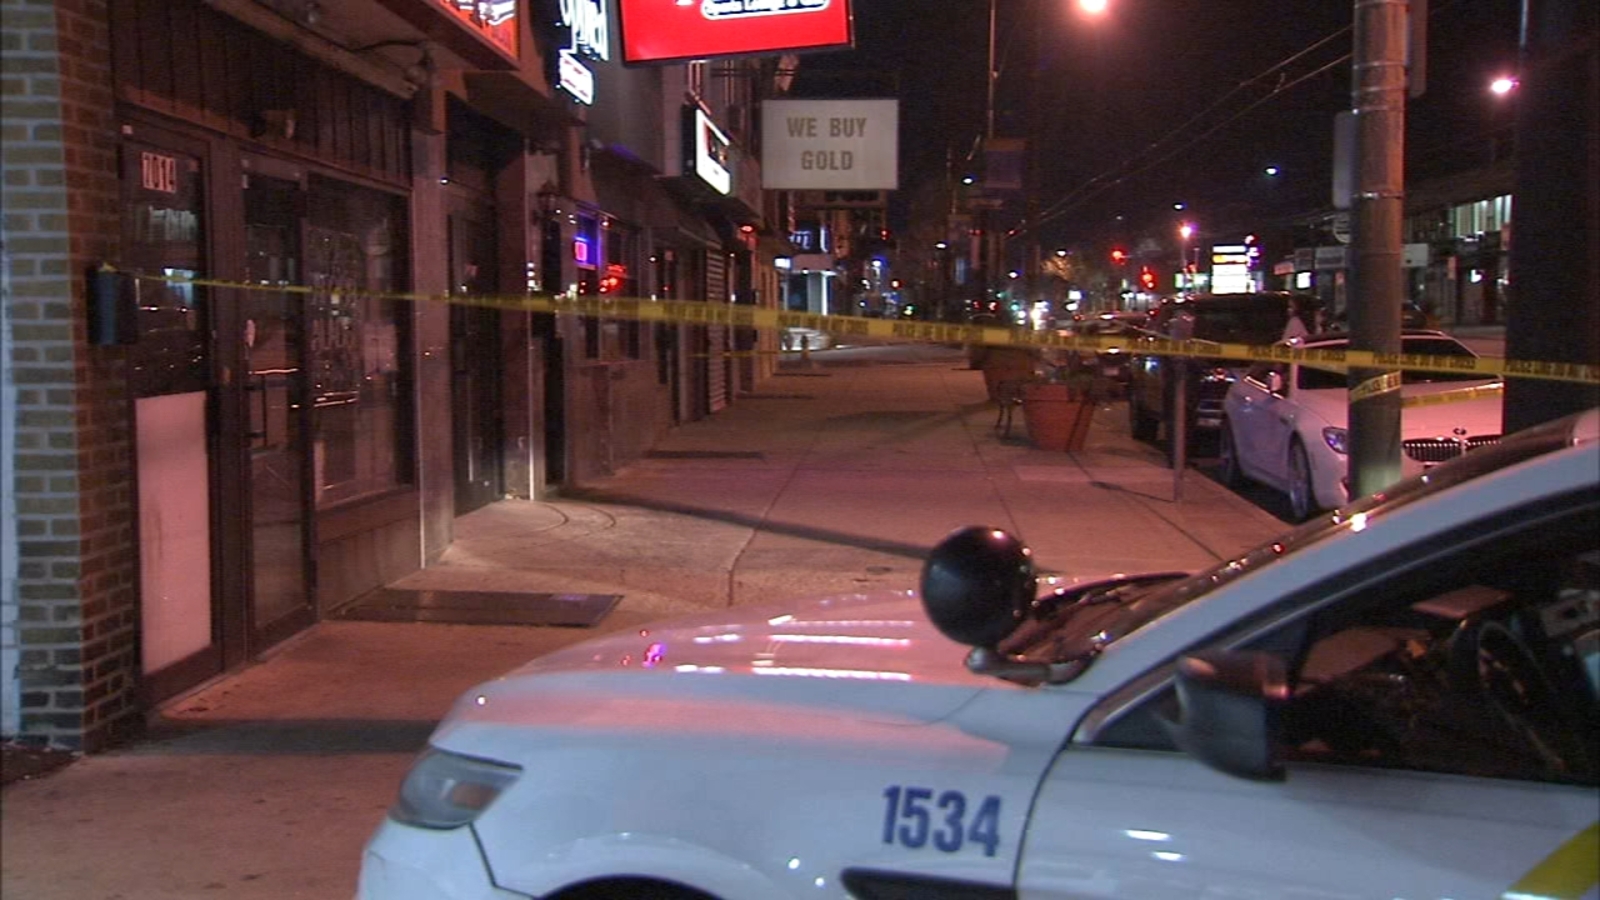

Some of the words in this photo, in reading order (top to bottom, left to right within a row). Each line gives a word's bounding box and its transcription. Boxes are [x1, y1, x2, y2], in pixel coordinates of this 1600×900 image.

[786, 117, 817, 138] WE
[829, 117, 867, 138] BUY
[142, 153, 176, 192] 7014
[801, 150, 853, 171] GOLD
[883, 785, 1002, 857] 1534
